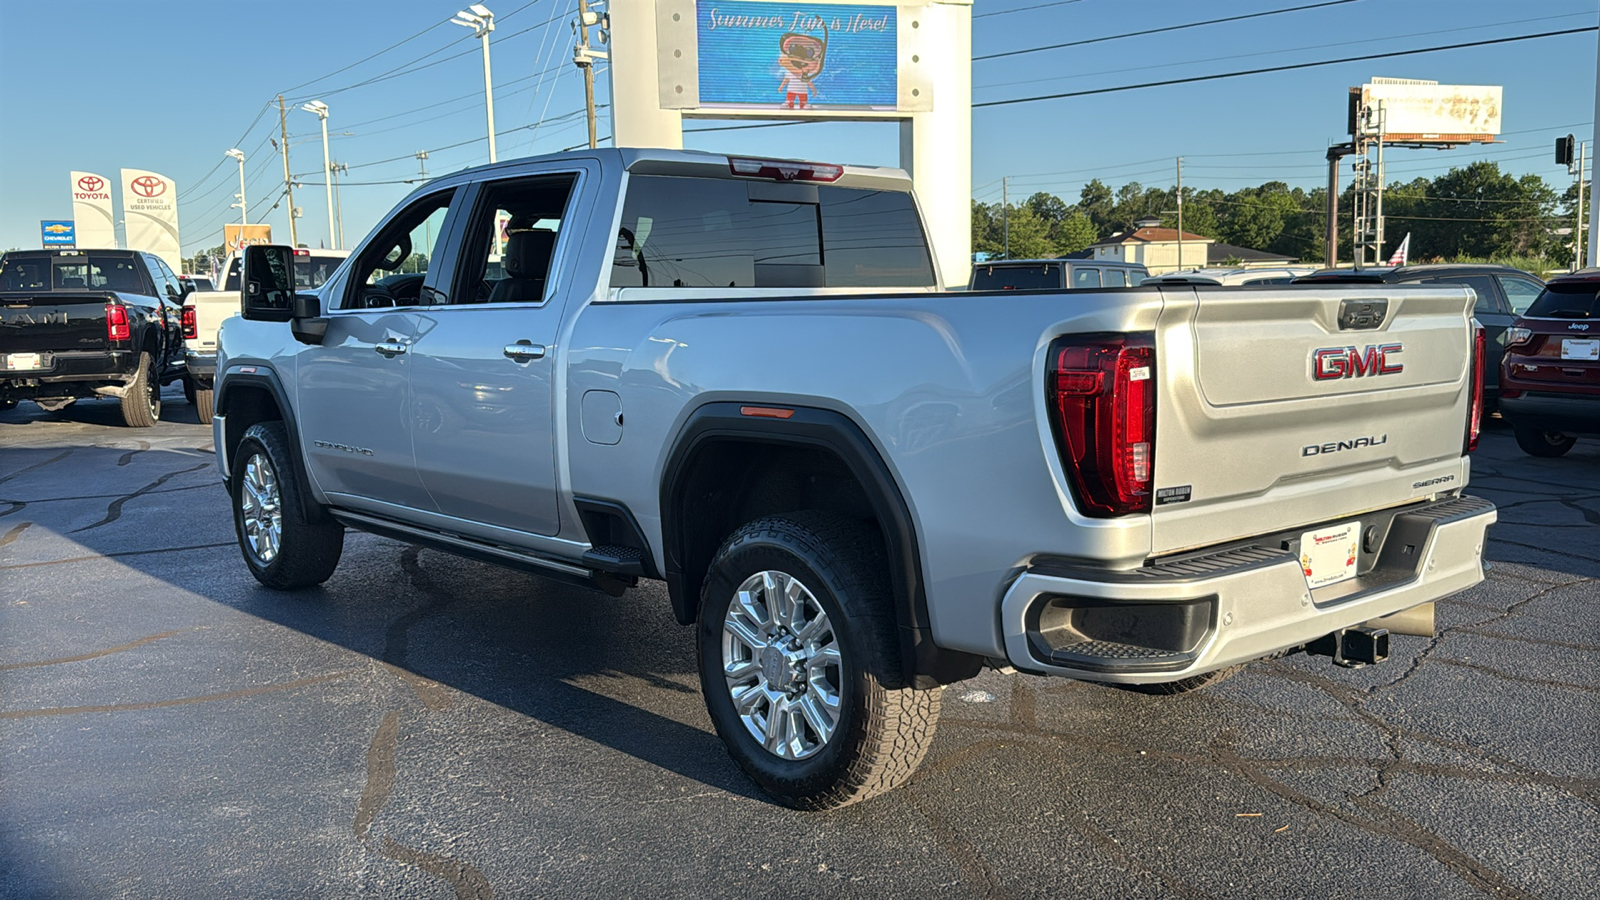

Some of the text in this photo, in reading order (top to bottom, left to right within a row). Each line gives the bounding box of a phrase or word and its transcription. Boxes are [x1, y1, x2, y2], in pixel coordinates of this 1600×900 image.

[707, 8, 887, 33] Summer Fun is Here!
[0, 312, 68, 325] AM
[1568, 323, 1589, 331] Jeep
[1312, 343, 1404, 381] GMC
[1302, 434, 1387, 456] DENALI
[1412, 475, 1455, 489] SIERRA
